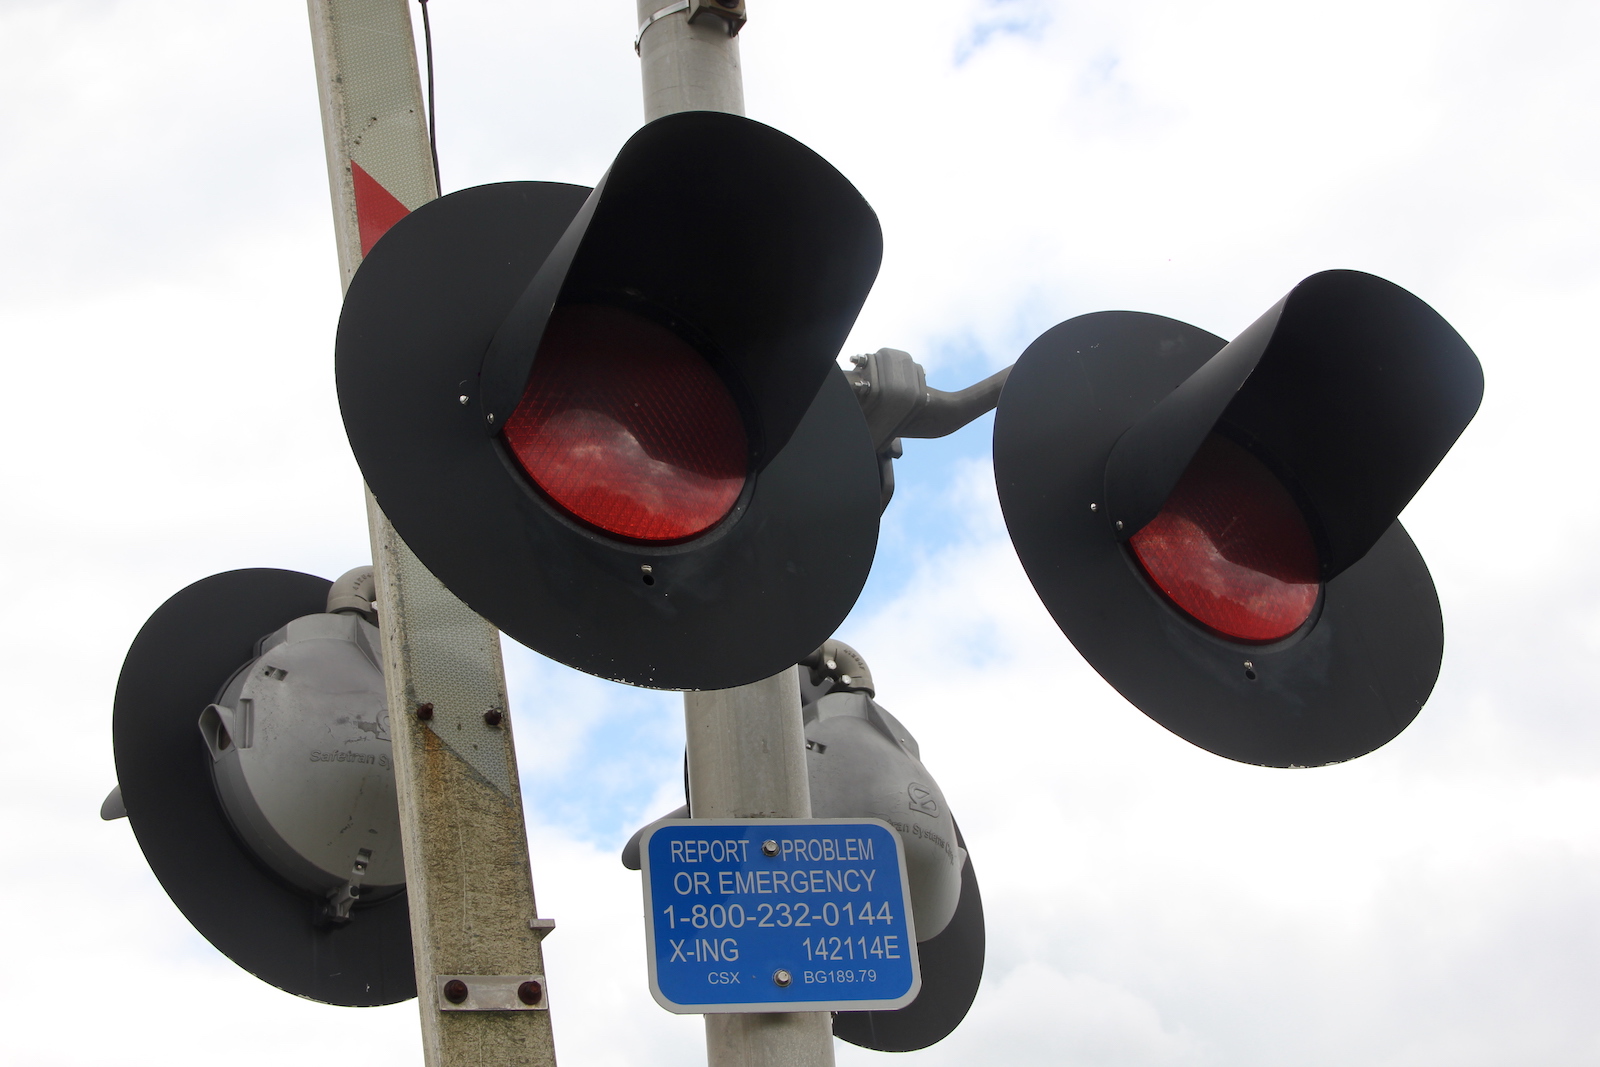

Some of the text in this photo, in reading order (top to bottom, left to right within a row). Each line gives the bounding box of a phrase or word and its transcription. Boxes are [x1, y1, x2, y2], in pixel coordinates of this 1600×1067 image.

[309, 749, 376, 765] Safetran
[671, 839, 874, 862] REPORT PROBLEM
[674, 870, 875, 895] OR EMERGENCY
[664, 902, 893, 928] 1-800-232-0144
[670, 936, 900, 962] X-ING 142114E
[708, 970, 876, 984] CSX BG189.79
